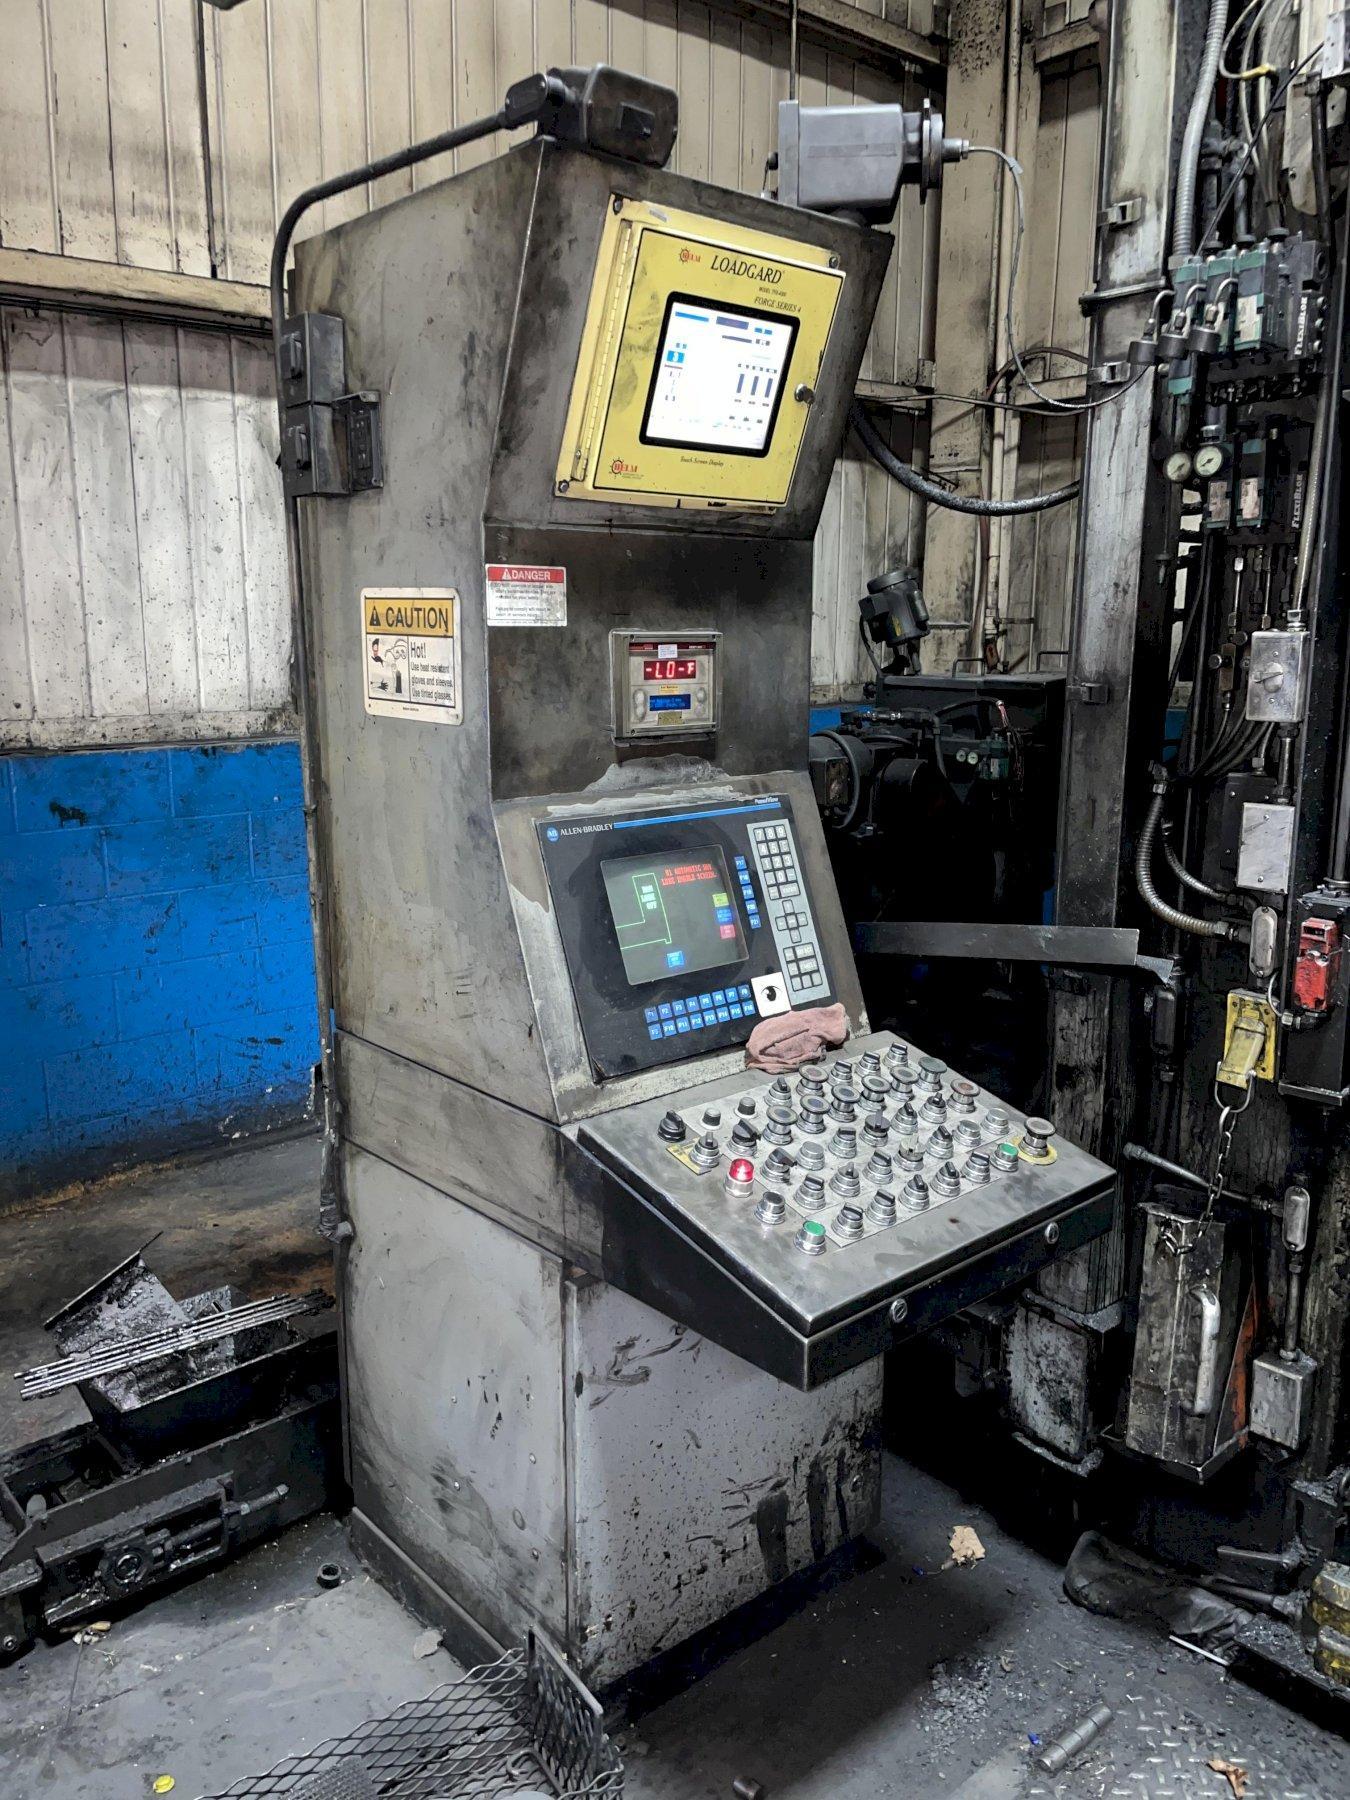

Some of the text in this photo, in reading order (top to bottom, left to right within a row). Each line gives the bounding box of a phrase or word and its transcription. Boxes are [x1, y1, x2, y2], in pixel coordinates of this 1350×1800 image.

[711, 255, 783, 284] LOADGARD
[754, 296, 775, 308] FORGE
[776, 301, 797, 313] SERIES
[693, 457, 708, 465] Screen
[709, 458, 725, 467] Display
[511, 569, 551, 581] DANGER
[385, 606, 449, 630] CAUTION
[410, 641, 427, 659] Hot!
[410, 662, 420, 671] Use
[420, 662, 430, 672] heat
[411, 675, 426, 686] gloves
[426, 676, 435, 686] and
[412, 687, 420, 697] Use
[420, 688, 433, 699] tinted
